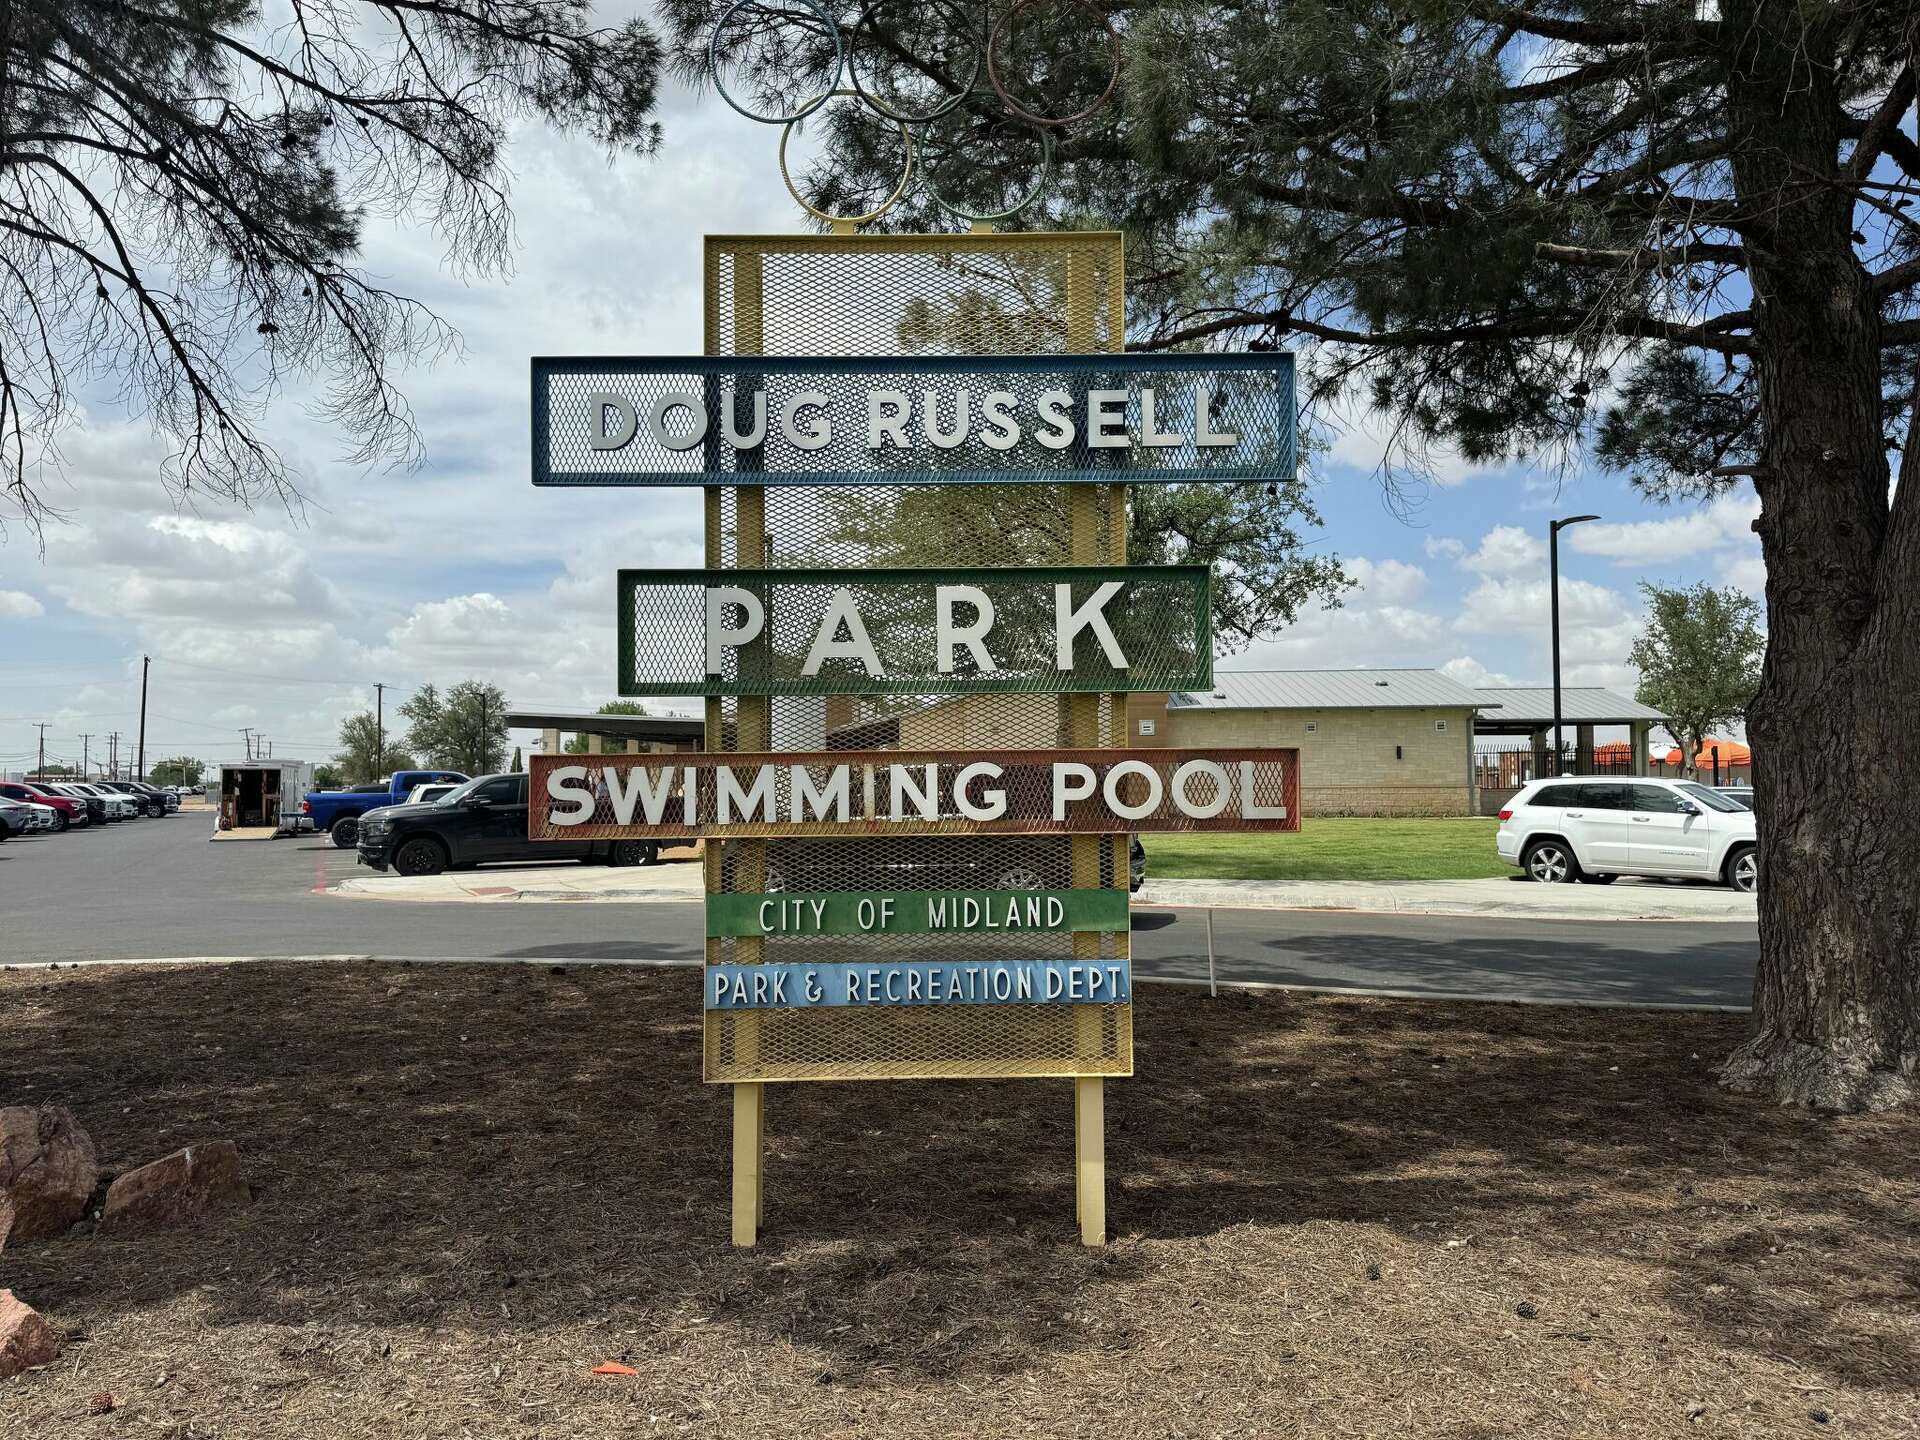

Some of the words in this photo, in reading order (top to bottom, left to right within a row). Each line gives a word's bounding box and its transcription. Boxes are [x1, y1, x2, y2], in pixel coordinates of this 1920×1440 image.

[590, 391, 833, 451] DOUG
[867, 387, 1239, 449] RUSSELL
[705, 581, 1129, 674] PARK
[547, 763, 1007, 826] SWIMMING
[1052, 760, 1287, 820] POOL
[759, 898, 825, 932] CITY
[857, 898, 895, 930] OF
[928, 896, 1064, 929] MIDLAND
[714, 970, 787, 1004] PARK
[805, 971, 823, 1002] &
[846, 967, 1032, 1002] RECREATION
[1046, 966, 1127, 1000] DEPT.
